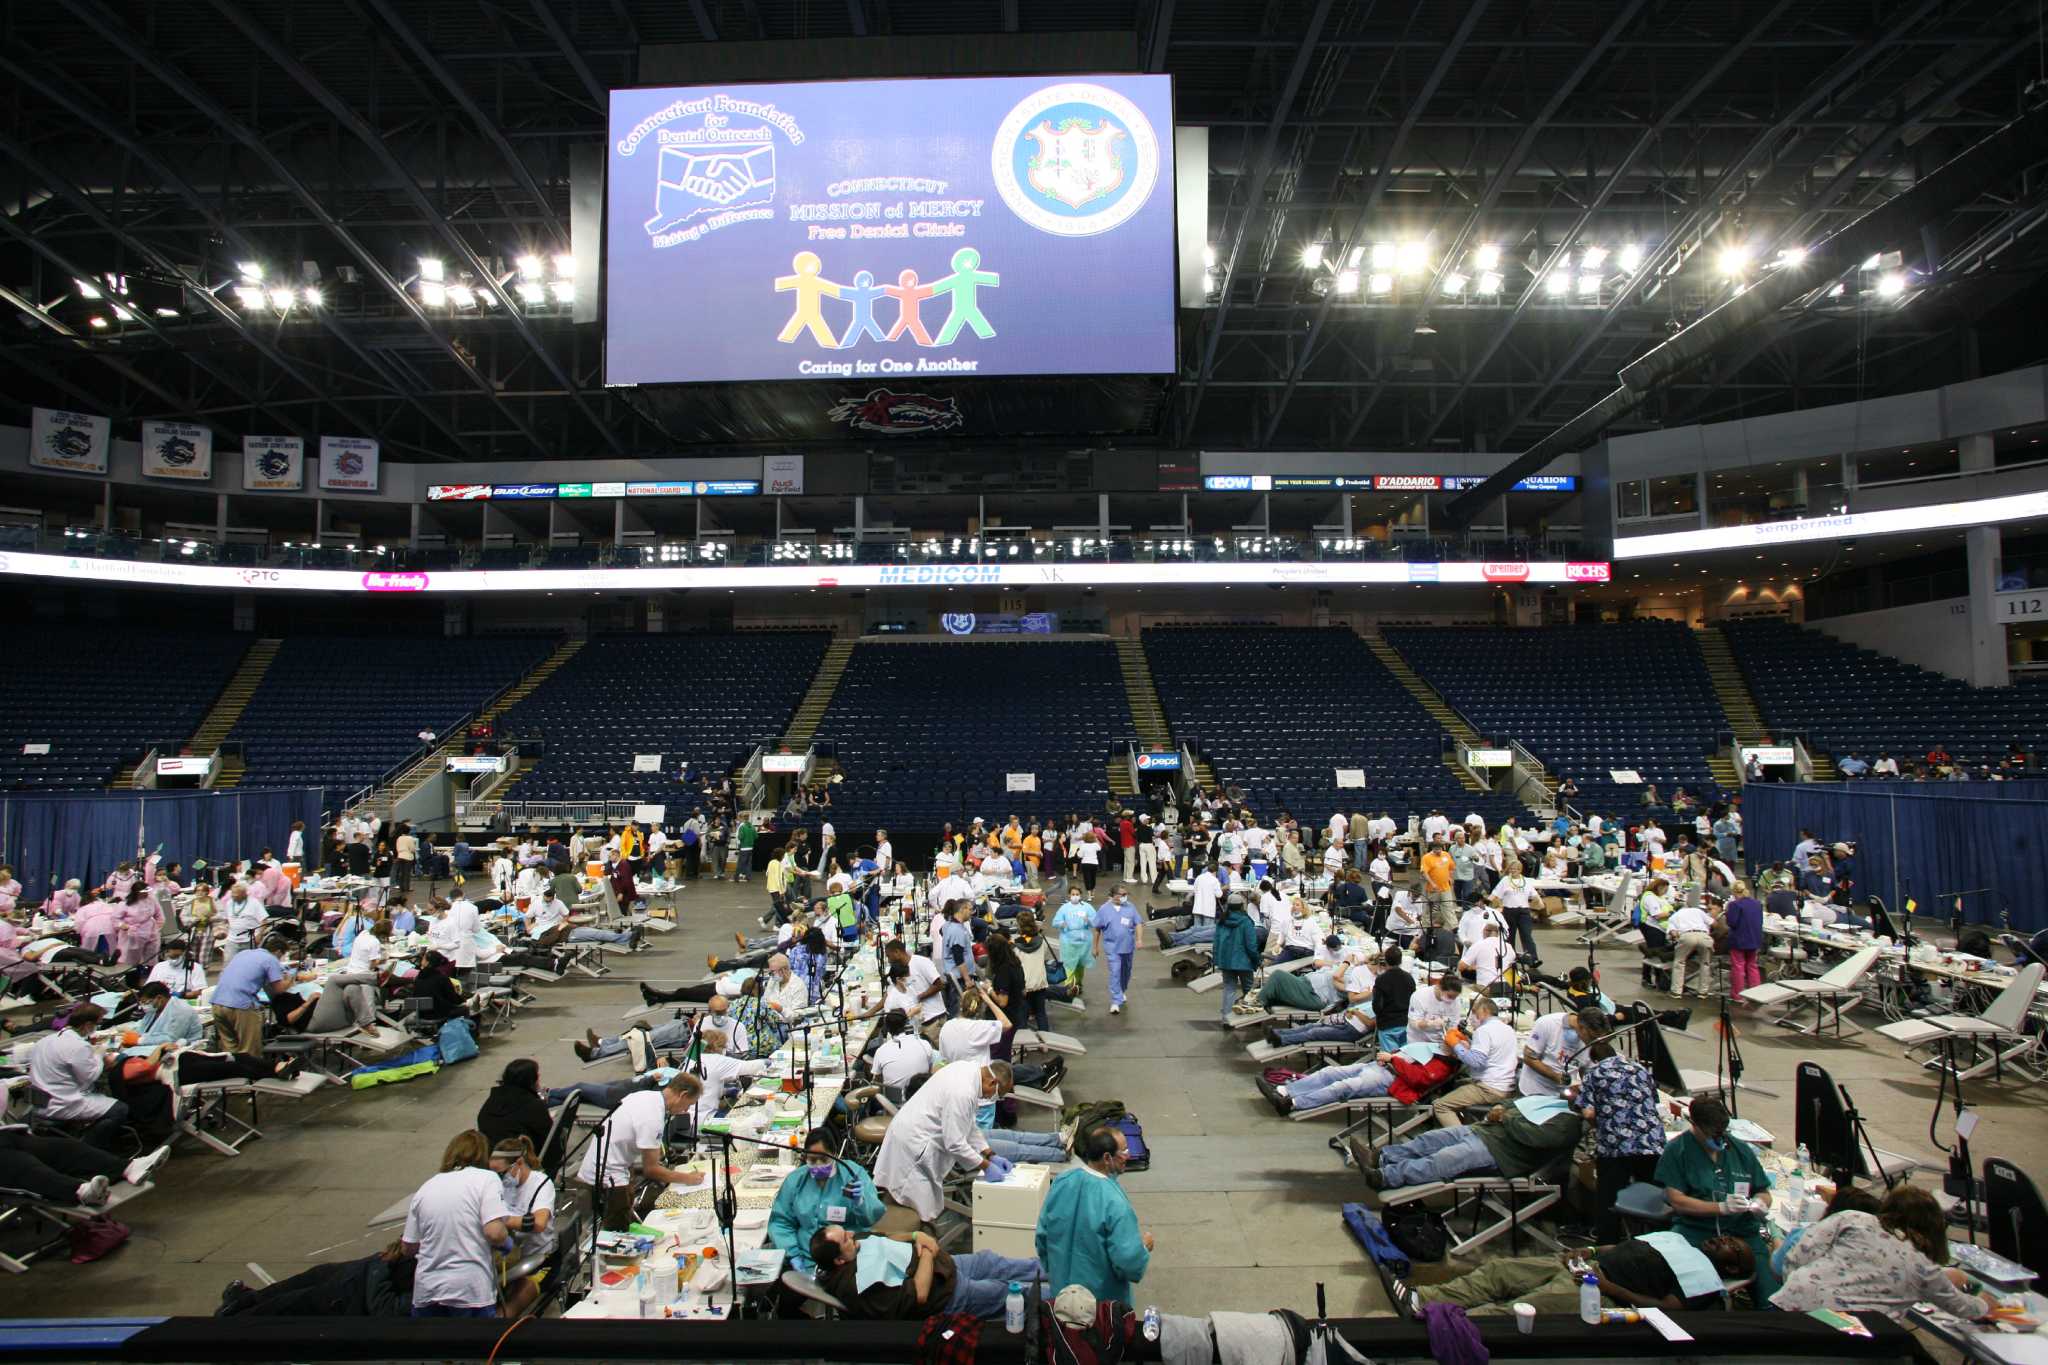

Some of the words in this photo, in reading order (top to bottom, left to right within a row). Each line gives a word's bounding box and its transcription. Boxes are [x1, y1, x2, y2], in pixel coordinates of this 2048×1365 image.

[618, 98, 712, 156] Connecticut
[714, 94, 805, 146] Foundation
[704, 113, 729, 128] for
[657, 128, 705, 144] Dental
[705, 126, 772, 142] Outreach
[827, 176, 949, 197] CONNECTICUT
[789, 202, 882, 221] MISSION
[884, 202, 904, 218] of
[908, 199, 985, 218] MERCY
[653, 226, 701, 248] Making
[707, 208, 774, 229] Difference
[807, 225, 847, 240] Free
[850, 223, 909, 239] Dental
[912, 221, 966, 238] Clinic
[798, 359, 853, 376] Caring
[856, 359, 877, 374] for
[880, 358, 913, 374] One
[916, 357, 979, 373] Another
[1379, 477, 1435, 486] D'ADDARIO
[1755, 516, 1853, 534] Sempermed
[880, 566, 1001, 583] MEDICOM
[1950, 604, 1966, 615] 112
[2007, 599, 2042, 615] 112
[1151, 756, 1178, 767] pepsi
